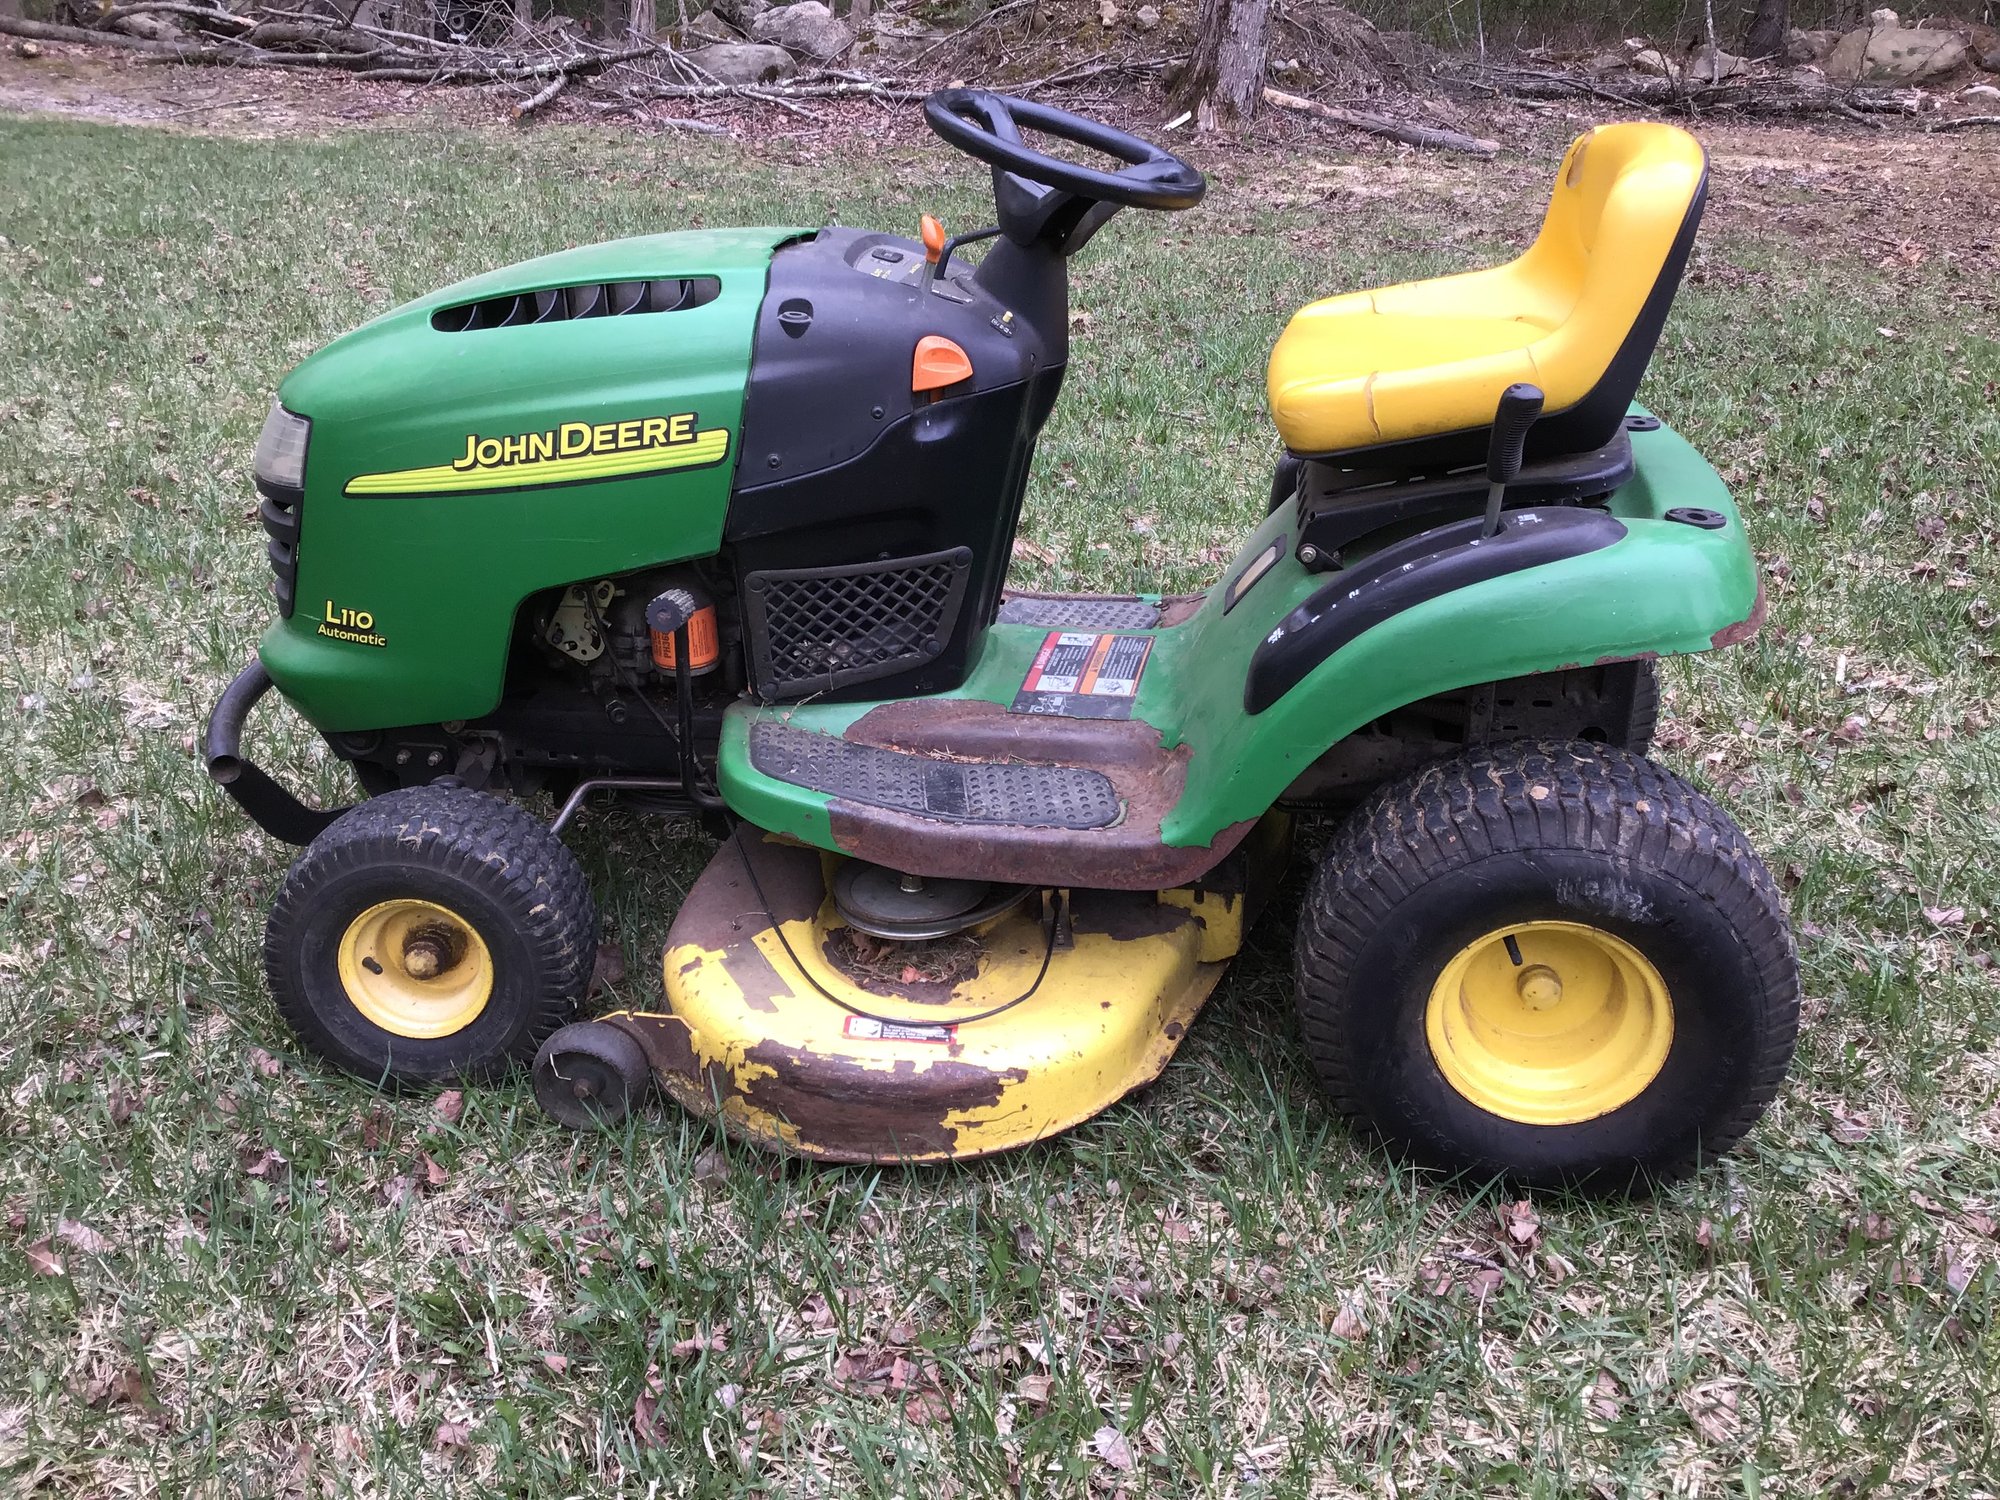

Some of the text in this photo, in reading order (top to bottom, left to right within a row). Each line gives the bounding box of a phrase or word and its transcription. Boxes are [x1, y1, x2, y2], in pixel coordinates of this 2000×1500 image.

[453, 412, 696, 469] JOHN DEERE
[326, 600, 373, 629] L110
[317, 623, 386, 646] Automatic
